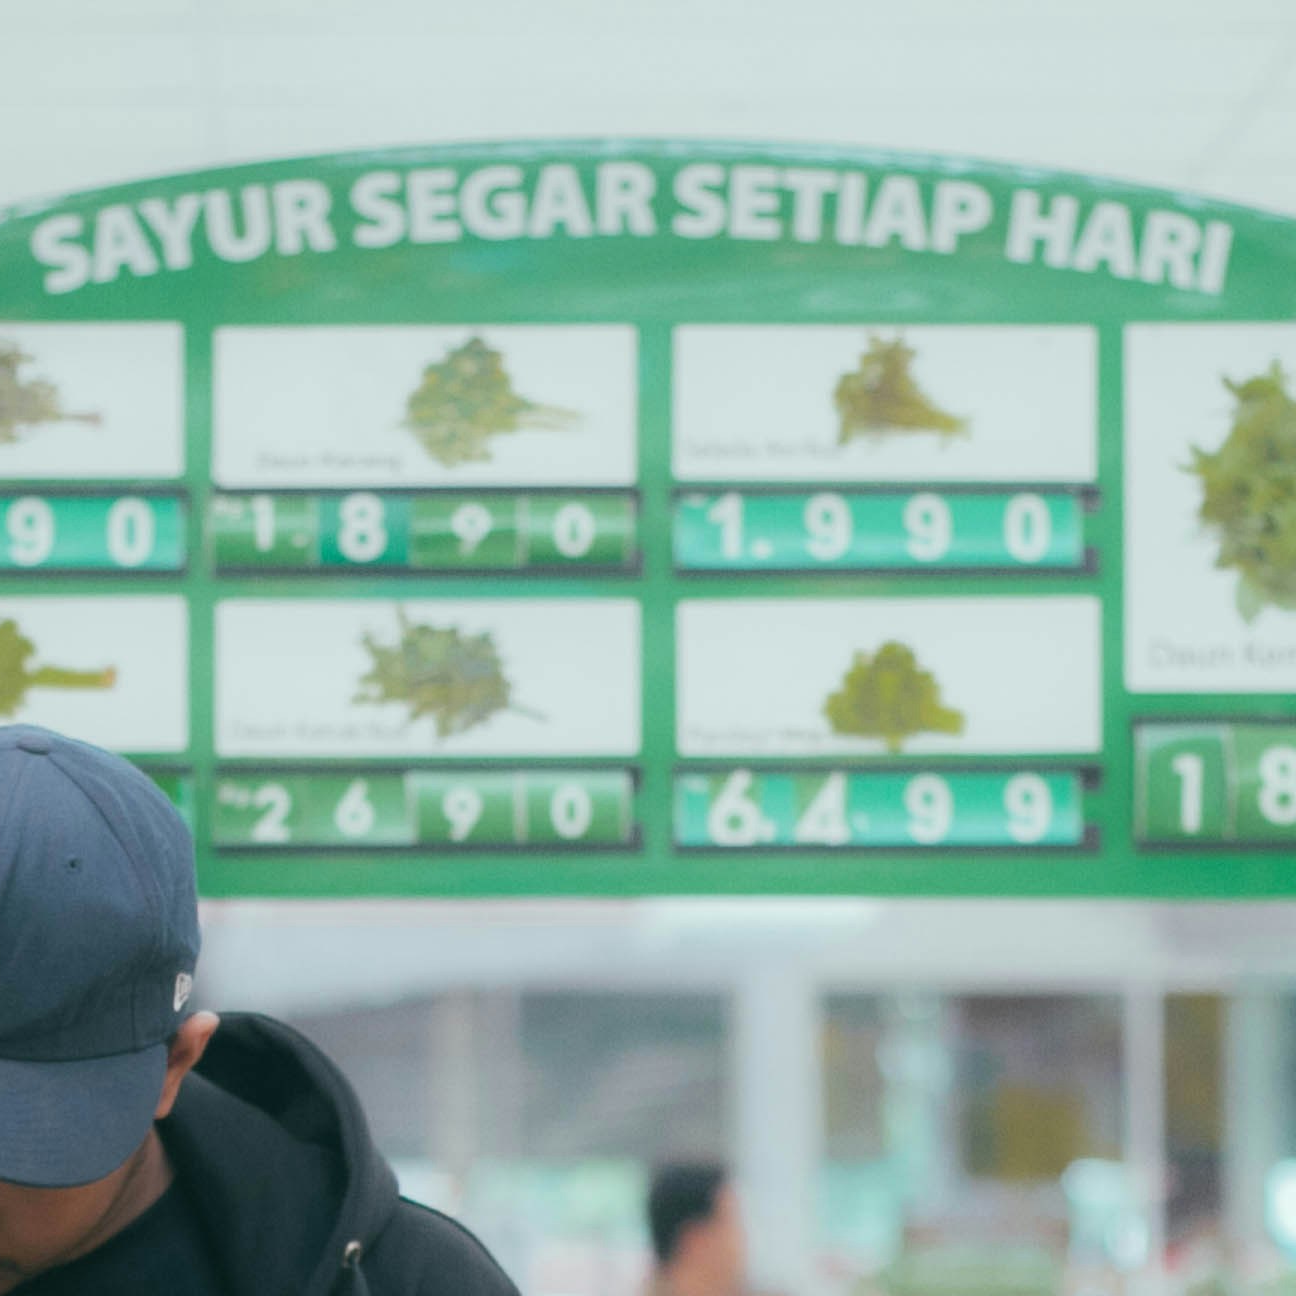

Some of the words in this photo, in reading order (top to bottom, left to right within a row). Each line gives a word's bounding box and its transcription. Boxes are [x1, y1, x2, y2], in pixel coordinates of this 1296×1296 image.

[28, 177, 338, 297] SAYUR
[349, 161, 658, 248] SEGAR
[670, 162, 995, 256] SETIAP
[1003, 188, 1235, 297] HARI
[707, 492, 1053, 562] 1.990
